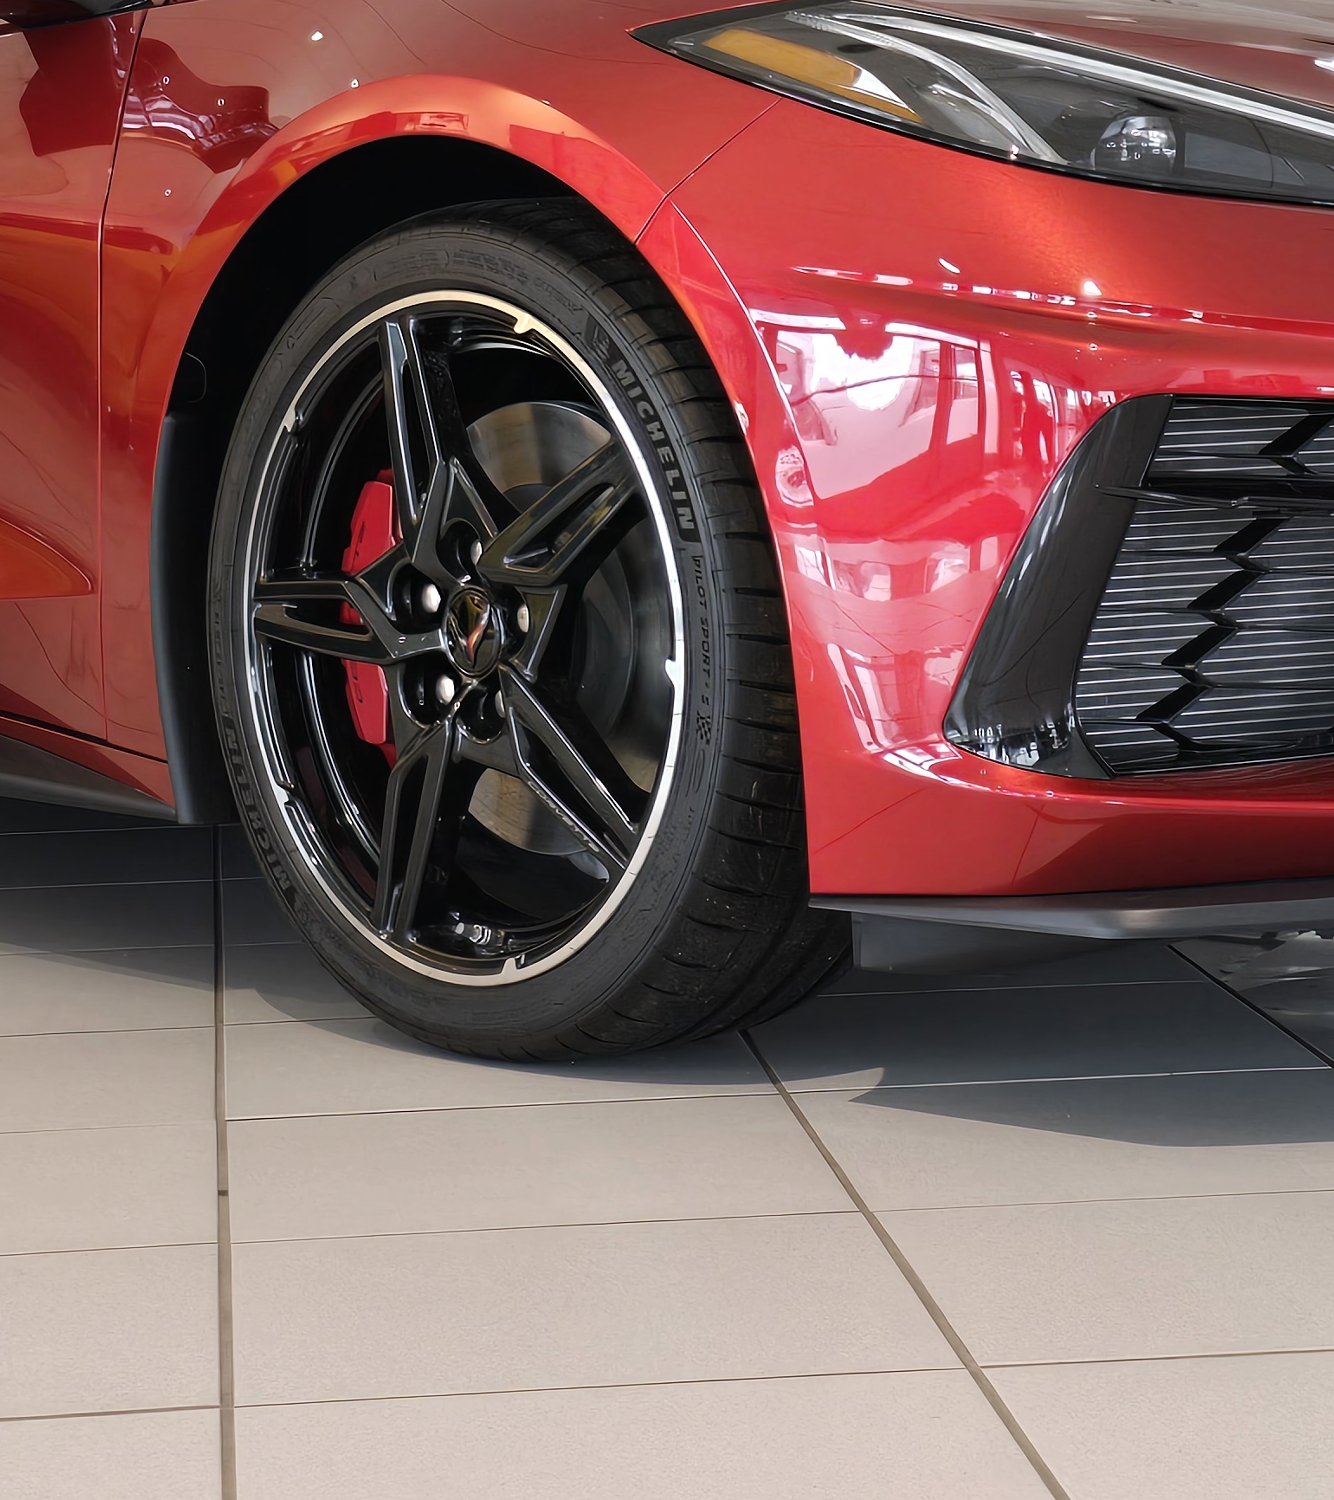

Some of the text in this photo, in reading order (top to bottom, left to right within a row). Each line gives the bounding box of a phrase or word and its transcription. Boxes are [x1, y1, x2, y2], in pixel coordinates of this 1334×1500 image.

[611, 359, 695, 530] MICHELIN
[692, 556, 708, 610] PILOT
[700, 617, 711, 678] SPORT
